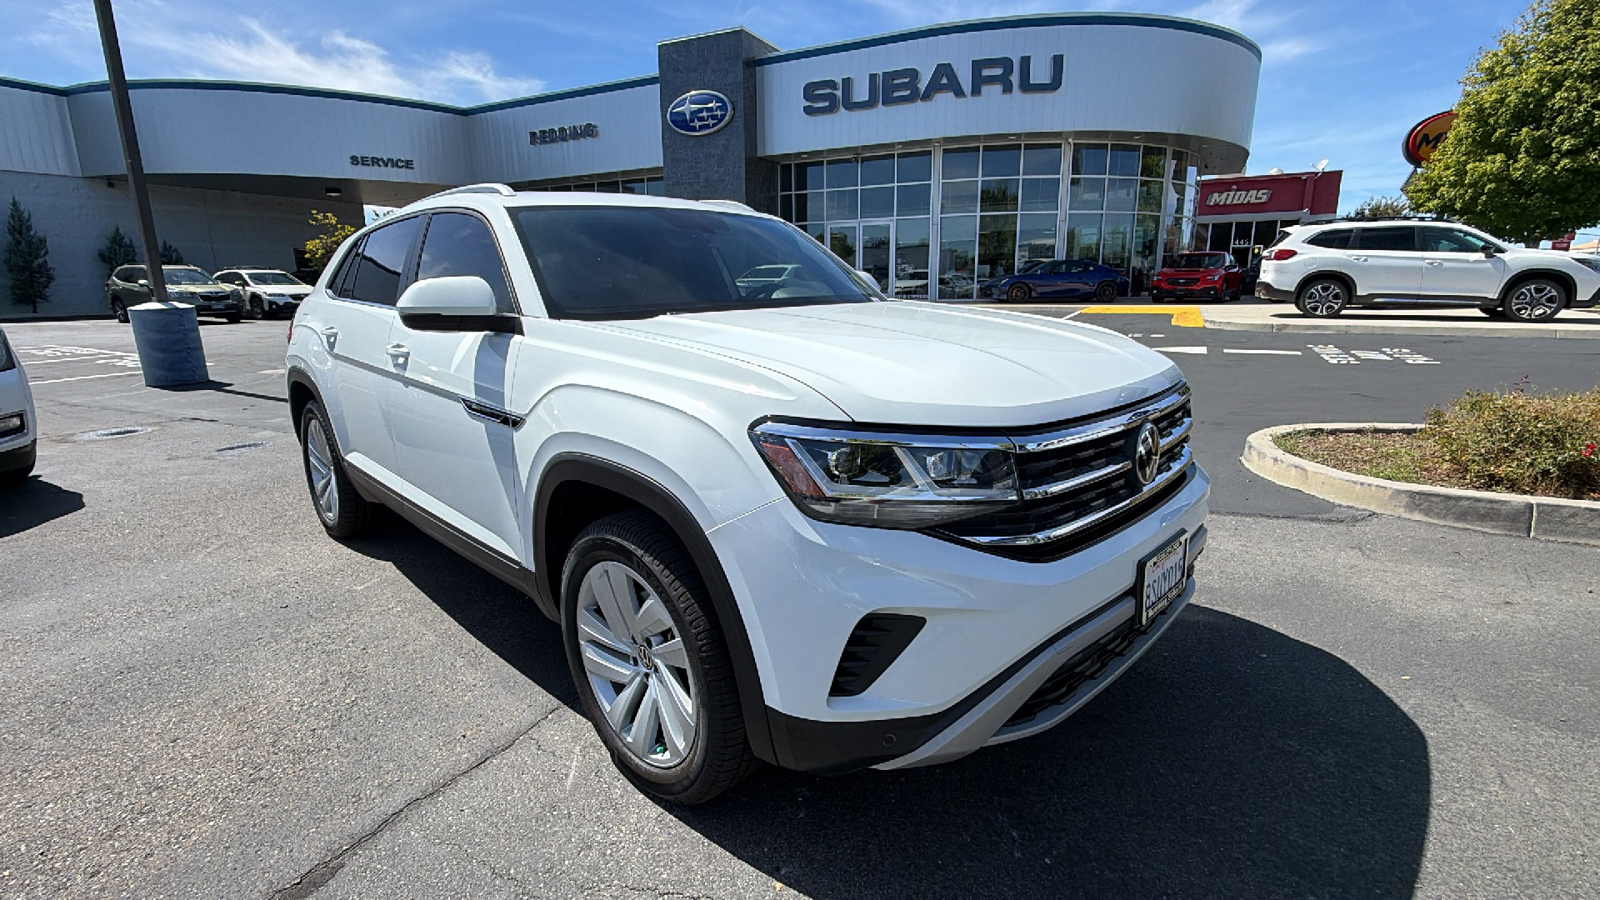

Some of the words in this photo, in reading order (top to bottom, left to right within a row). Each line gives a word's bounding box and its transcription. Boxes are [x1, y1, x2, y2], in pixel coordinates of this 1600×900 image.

[803, 54, 1064, 116] SUBARU
[529, 122, 599, 145] REDDING
[350, 155, 415, 170] SERVICE
